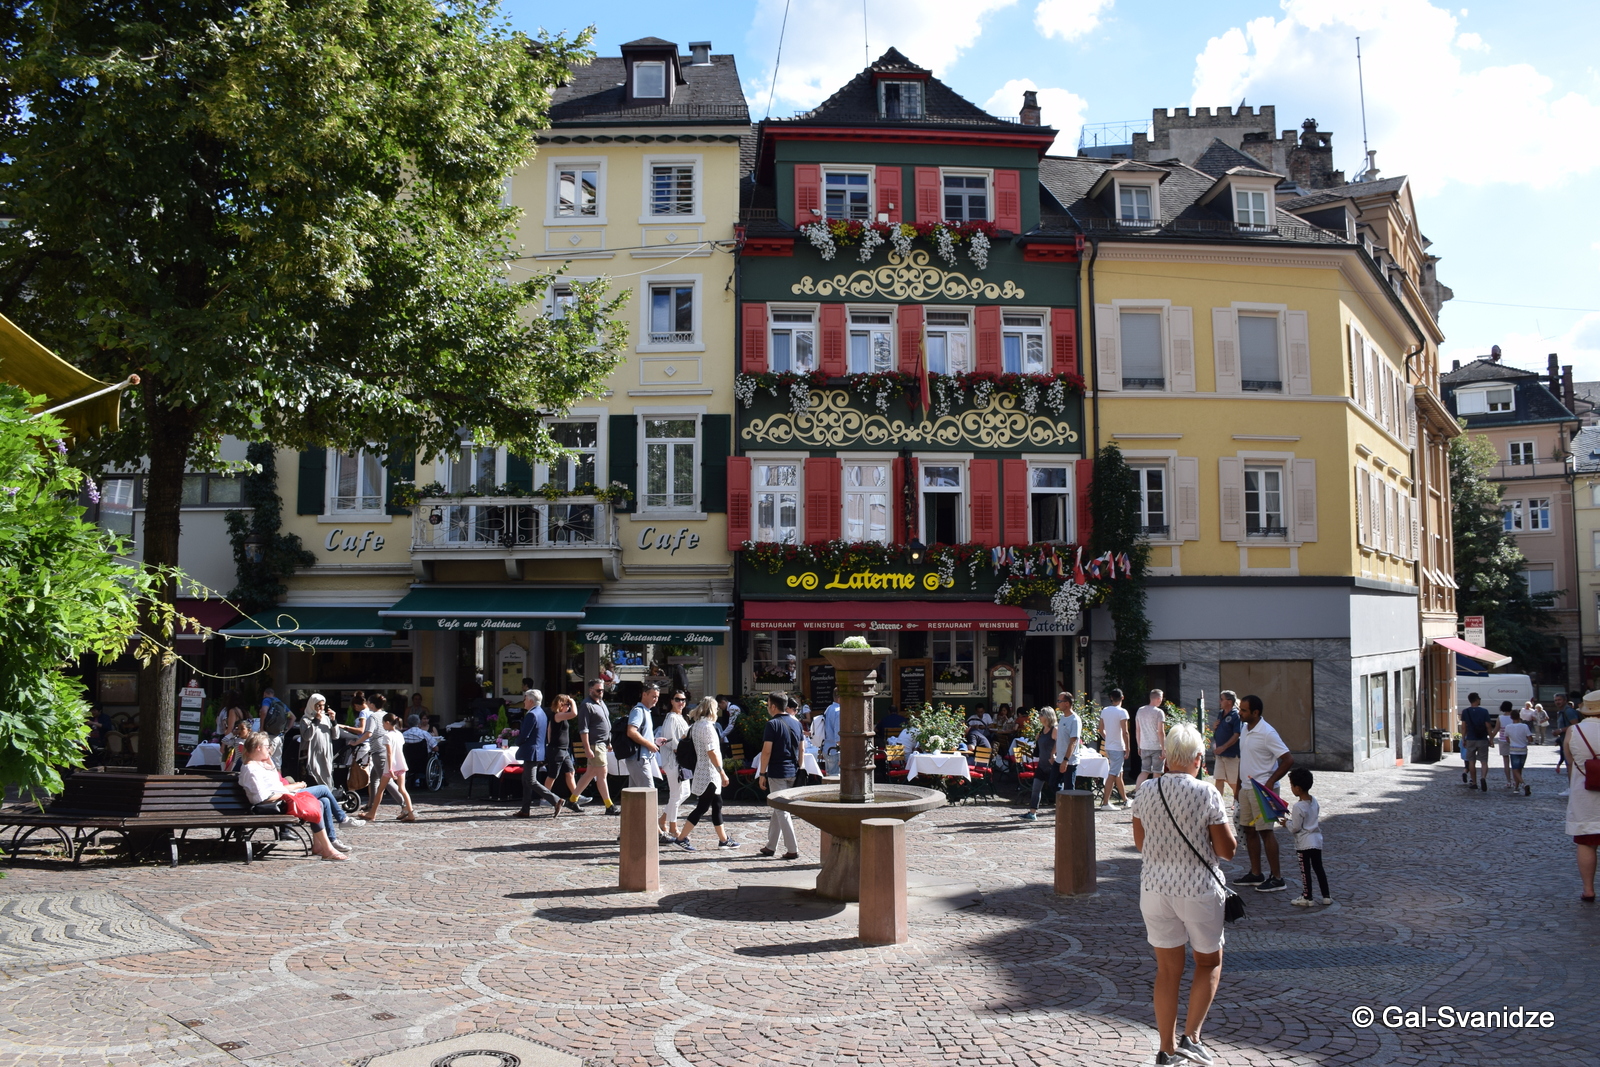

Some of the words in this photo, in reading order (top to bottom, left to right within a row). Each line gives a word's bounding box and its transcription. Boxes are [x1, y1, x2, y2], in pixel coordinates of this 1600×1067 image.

[324, 528, 385, 558] Cafe
[636, 526, 700, 556] Cafe
[824, 568, 916, 590] Laterne
[437, 618, 460, 630] Cafe
[481, 618, 521, 628] Rathaus
[869, 620, 903, 630] Laterne
[1026, 616, 1076, 632] Laterne
[267, 636, 288, 647] Cafe
[309, 636, 349, 646] Rathaus
[585, 631, 609, 643] Cafe
[620, 632, 672, 642] Restaurant
[684, 632, 714, 643] Bistro
